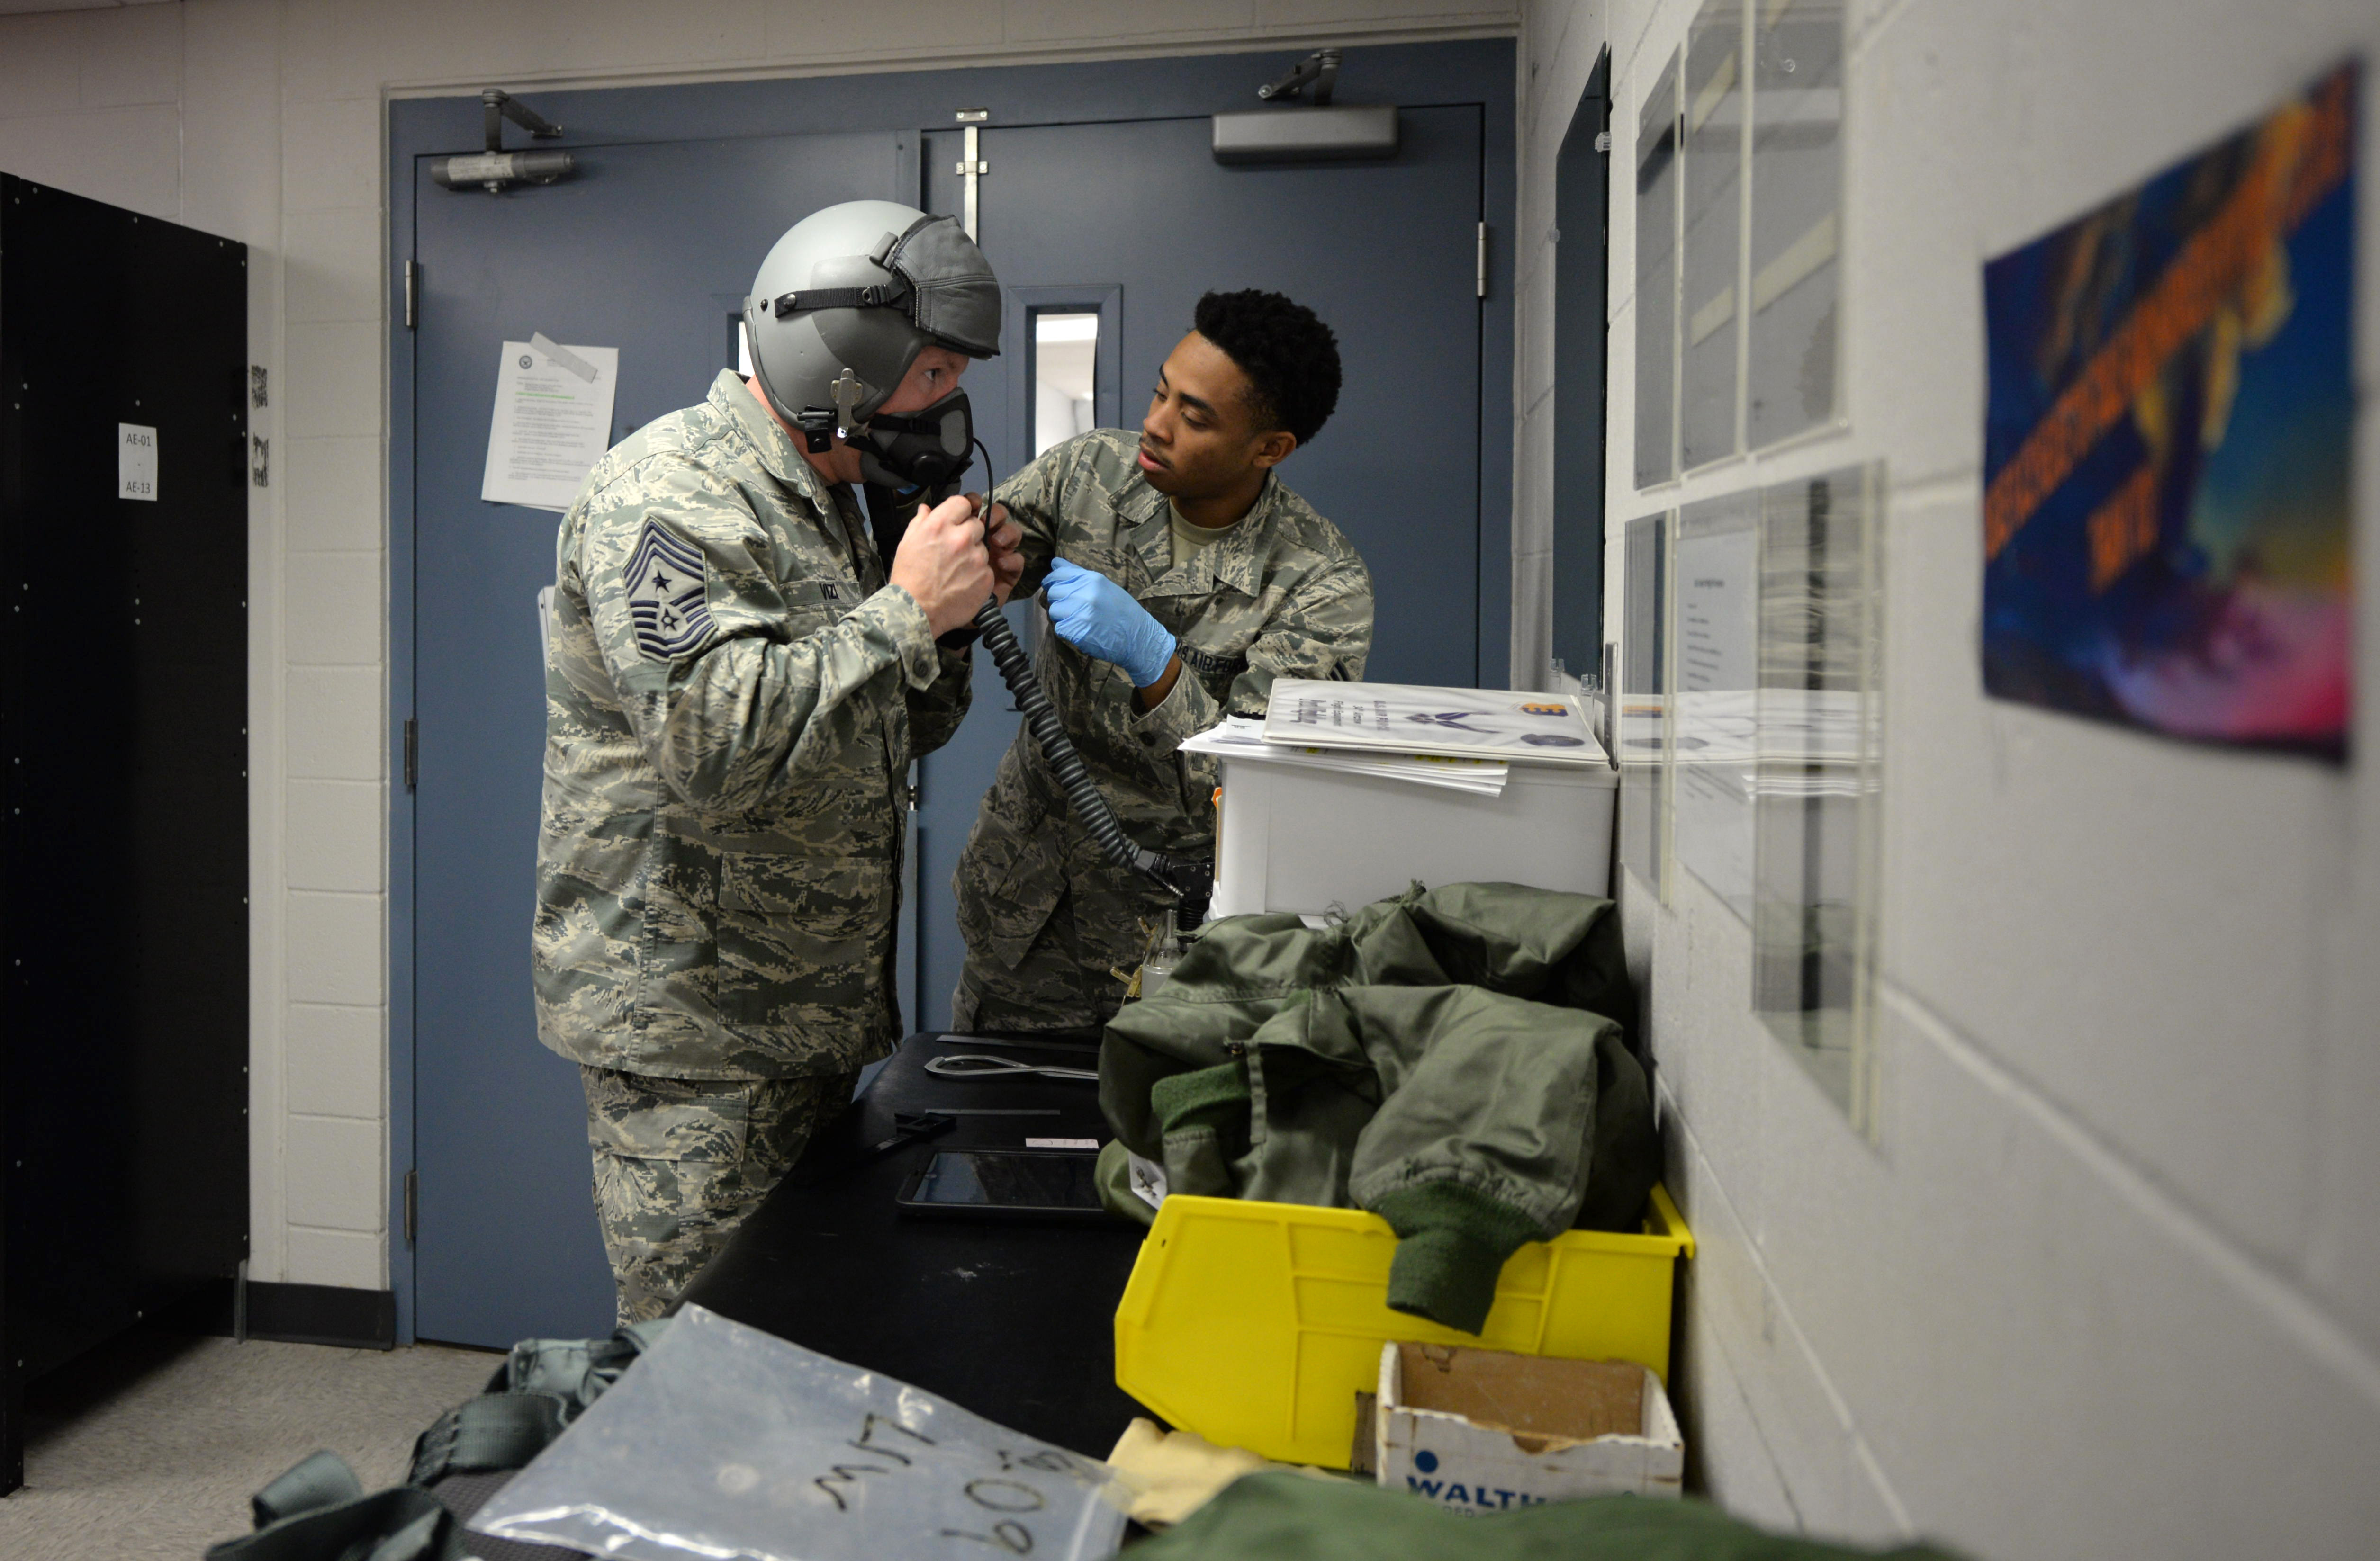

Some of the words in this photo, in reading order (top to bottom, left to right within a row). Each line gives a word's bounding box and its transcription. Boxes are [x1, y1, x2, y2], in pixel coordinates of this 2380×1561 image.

[126, 433, 151, 447] AE-01
[126, 481, 151, 494] AE-13
[1190, 650, 1213, 672] AIR
